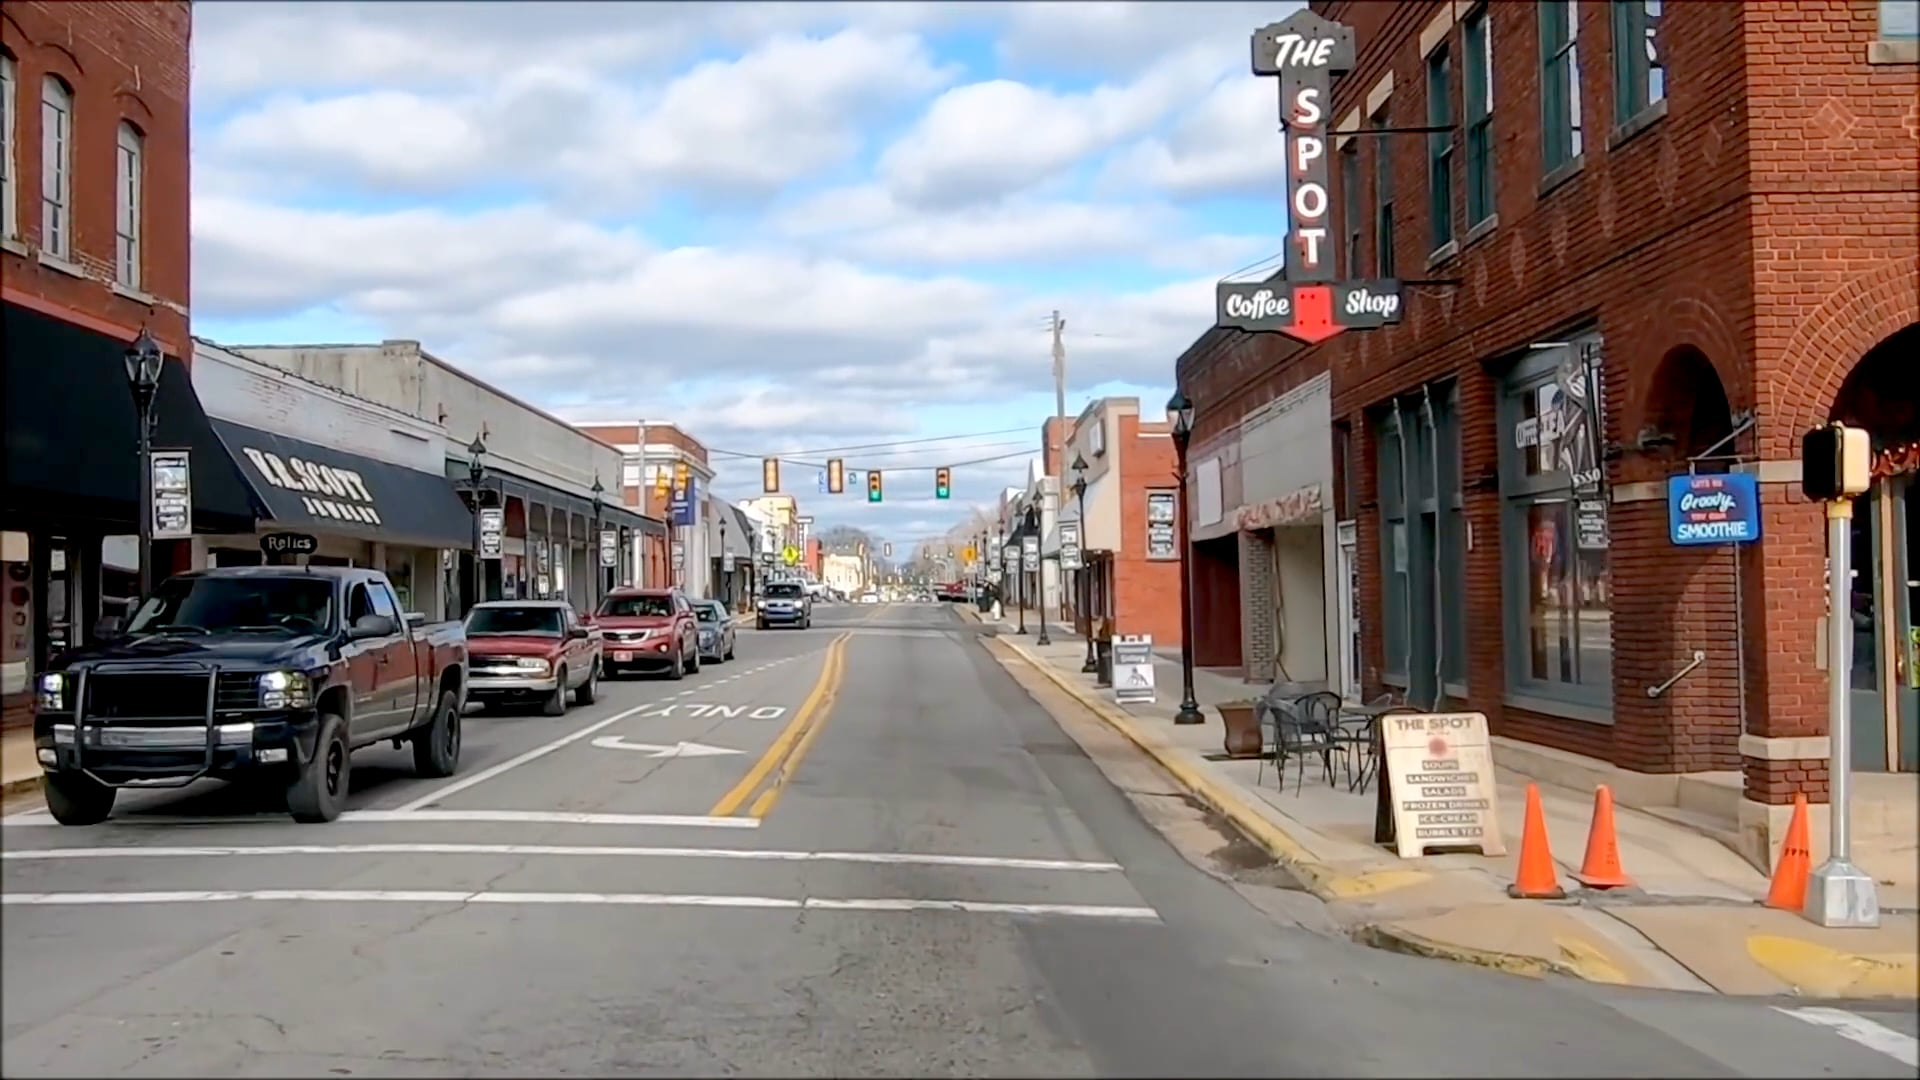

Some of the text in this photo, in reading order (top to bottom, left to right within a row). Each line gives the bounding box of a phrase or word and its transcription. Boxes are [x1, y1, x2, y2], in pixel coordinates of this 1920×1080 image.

[1275, 34, 1335, 68] THE
[1295, 87, 1328, 265] SPOT
[1226, 287, 1400, 320] Coffee Shop
[290, 456, 374, 502] SCOTT
[1677, 521, 1748, 539] SMOOTHIE
[268, 536, 312, 551] Relics
[641, 704, 786, 719] ONLY
[1395, 717, 1475, 730] THE SPOT
[1407, 773, 1477, 783] SANDWICHES
[1422, 787, 1465, 796] SALADS
[1404, 801, 1447, 810] FROZEN
[1417, 828, 1482, 837] BUBBLE TEA
